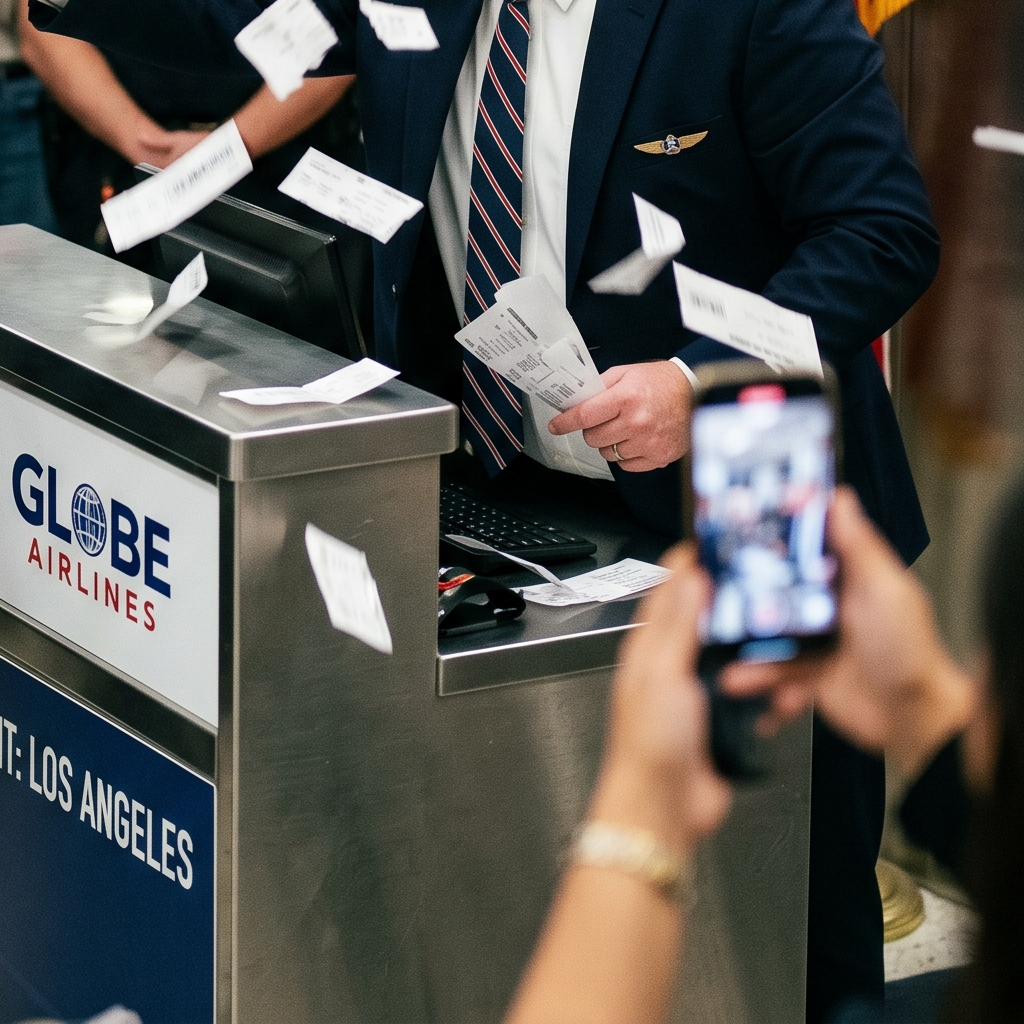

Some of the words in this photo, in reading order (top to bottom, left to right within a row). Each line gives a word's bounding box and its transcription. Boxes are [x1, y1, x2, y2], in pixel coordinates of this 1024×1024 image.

[12, 453, 171, 599] GLOBE
[27, 537, 156, 632] AIRLINES
[29, 734, 74, 813] LOS
[79, 769, 194, 891] ANGELES
